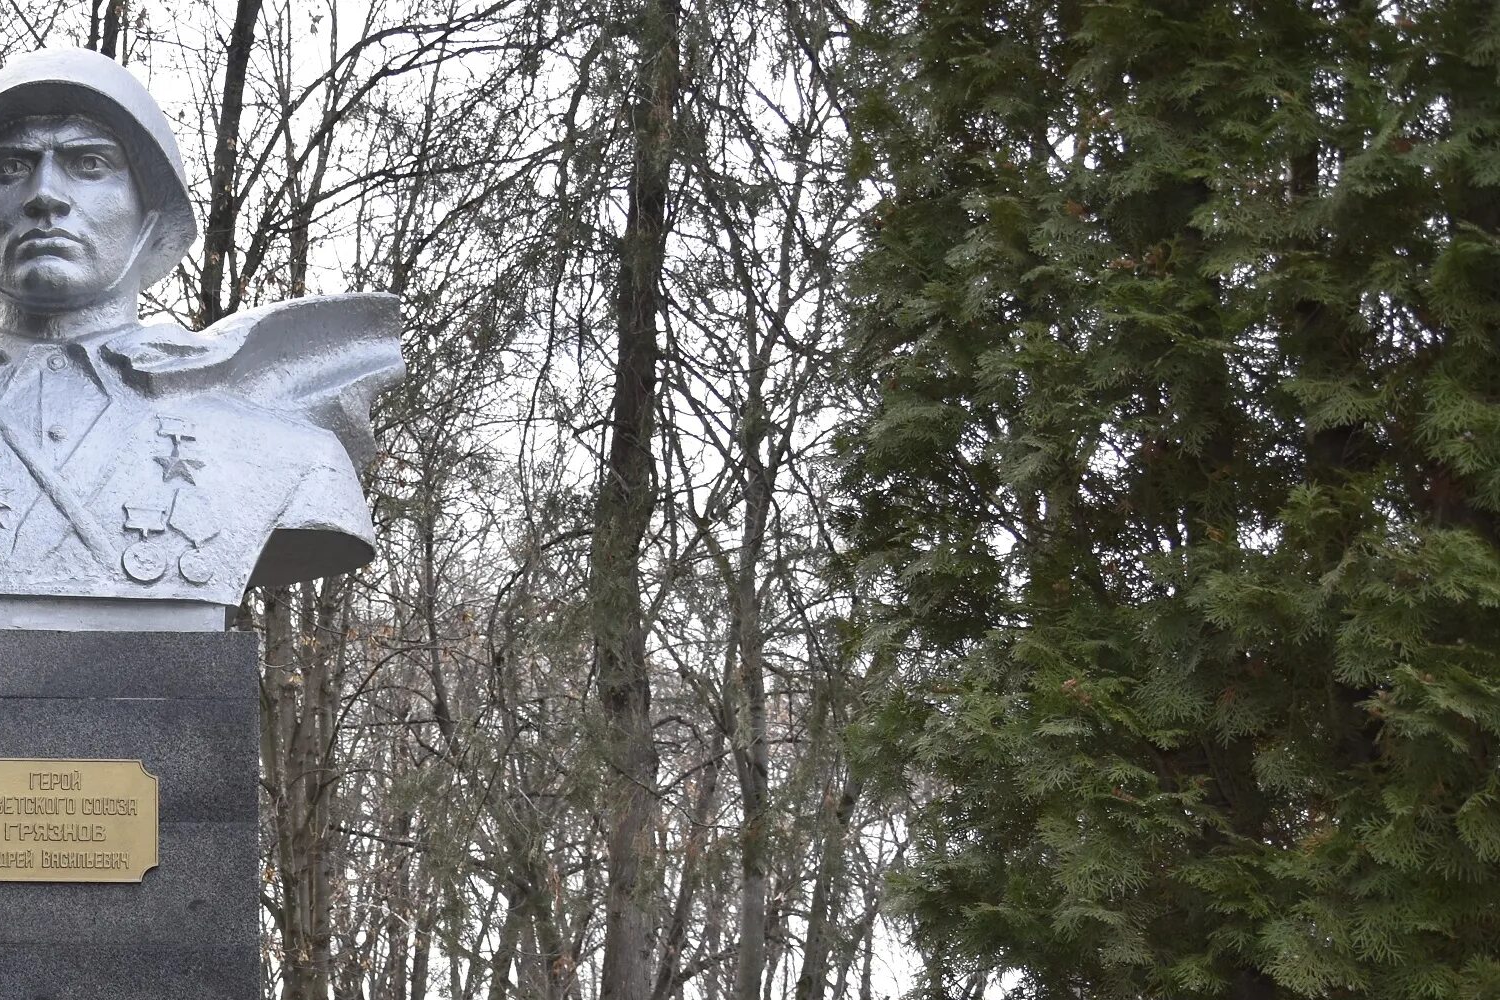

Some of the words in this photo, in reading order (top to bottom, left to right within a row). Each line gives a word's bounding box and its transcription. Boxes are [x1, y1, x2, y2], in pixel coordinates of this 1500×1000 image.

[29, 771, 81, 791] ГЕРОЙ
[81, 798, 138, 816] СОЮЗА
[4, 823, 107, 842] ГРЯЗНОВ
[41, 850, 130, 870] ВАСИЛЬЕВИЧ
